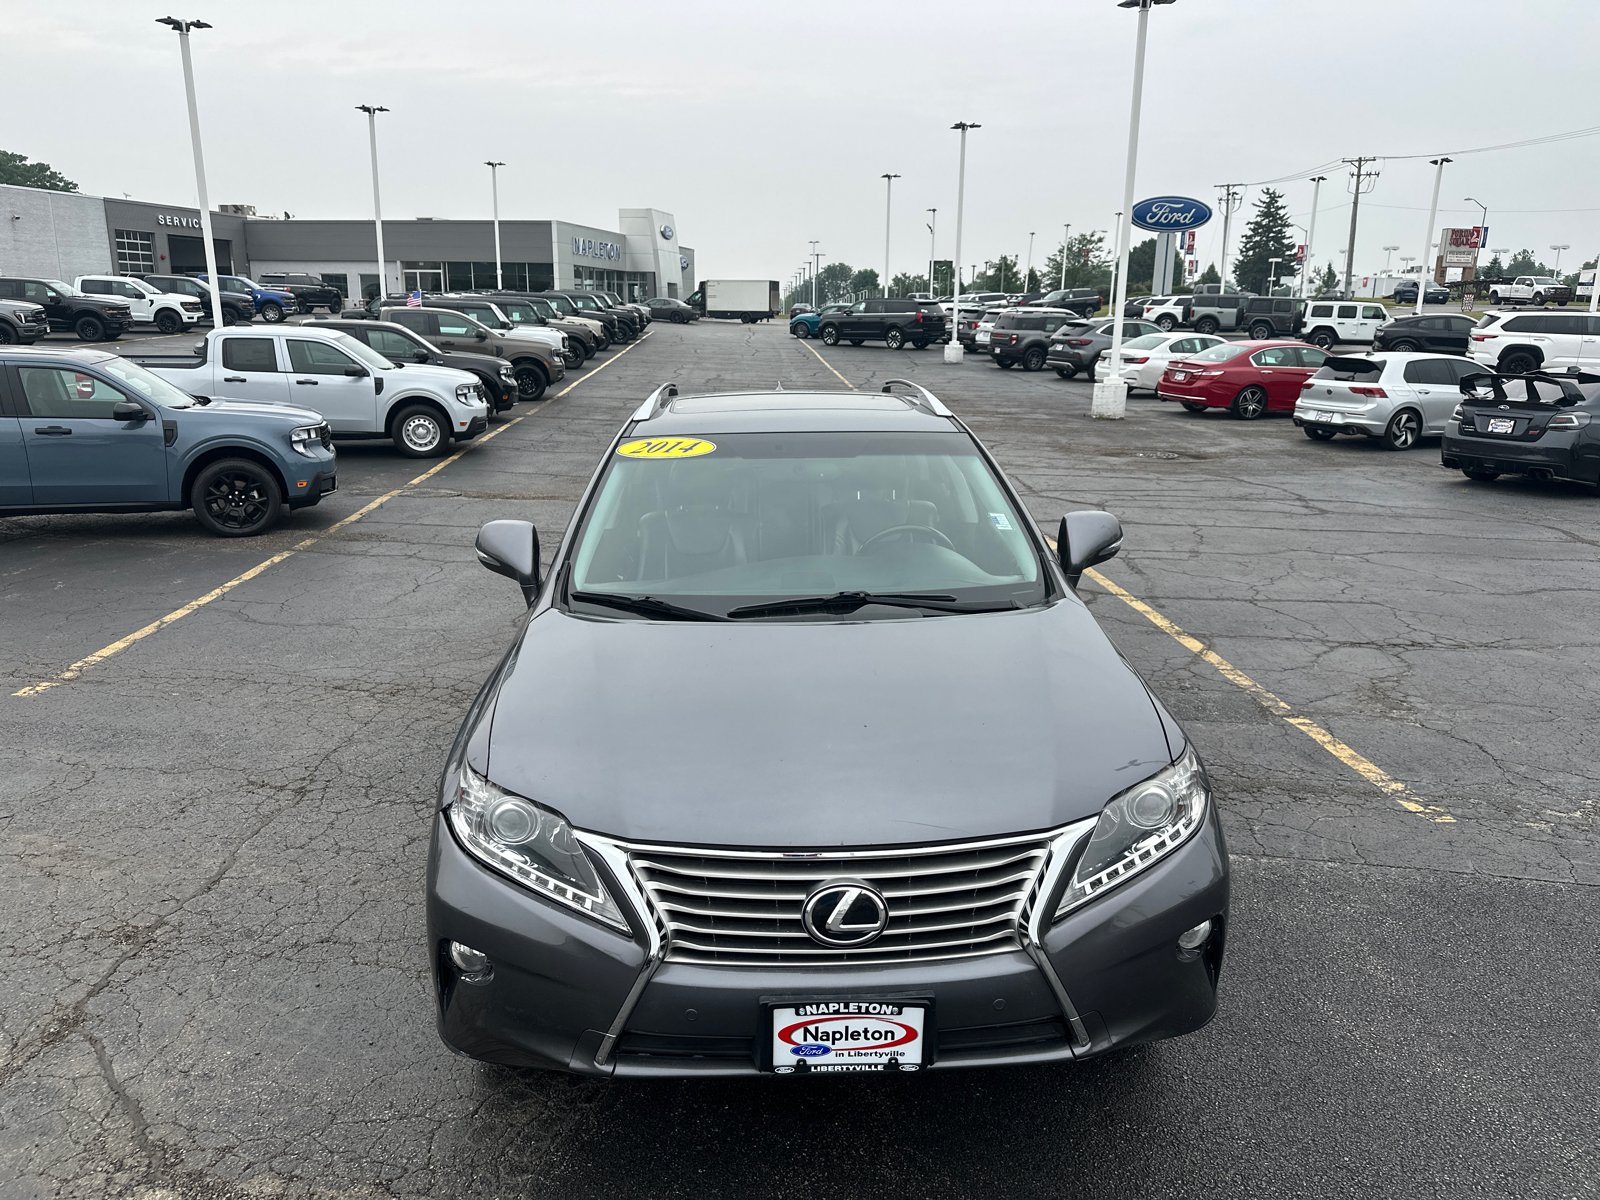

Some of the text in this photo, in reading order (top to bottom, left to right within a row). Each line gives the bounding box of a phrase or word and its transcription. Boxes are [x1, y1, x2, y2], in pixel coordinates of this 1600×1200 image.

[1146, 202, 1196, 224] Ford
[158, 214, 202, 229] SERVIC
[573, 237, 621, 260] NAPLETON
[1449, 237, 1471, 247] SQUAR
[628, 441, 702, 454] 2014
[806, 1003, 893, 1015] NAPLETON
[803, 1026, 895, 1045] Napleton
[799, 1046, 824, 1055] Ford
[848, 1050, 906, 1058] Libertyville
